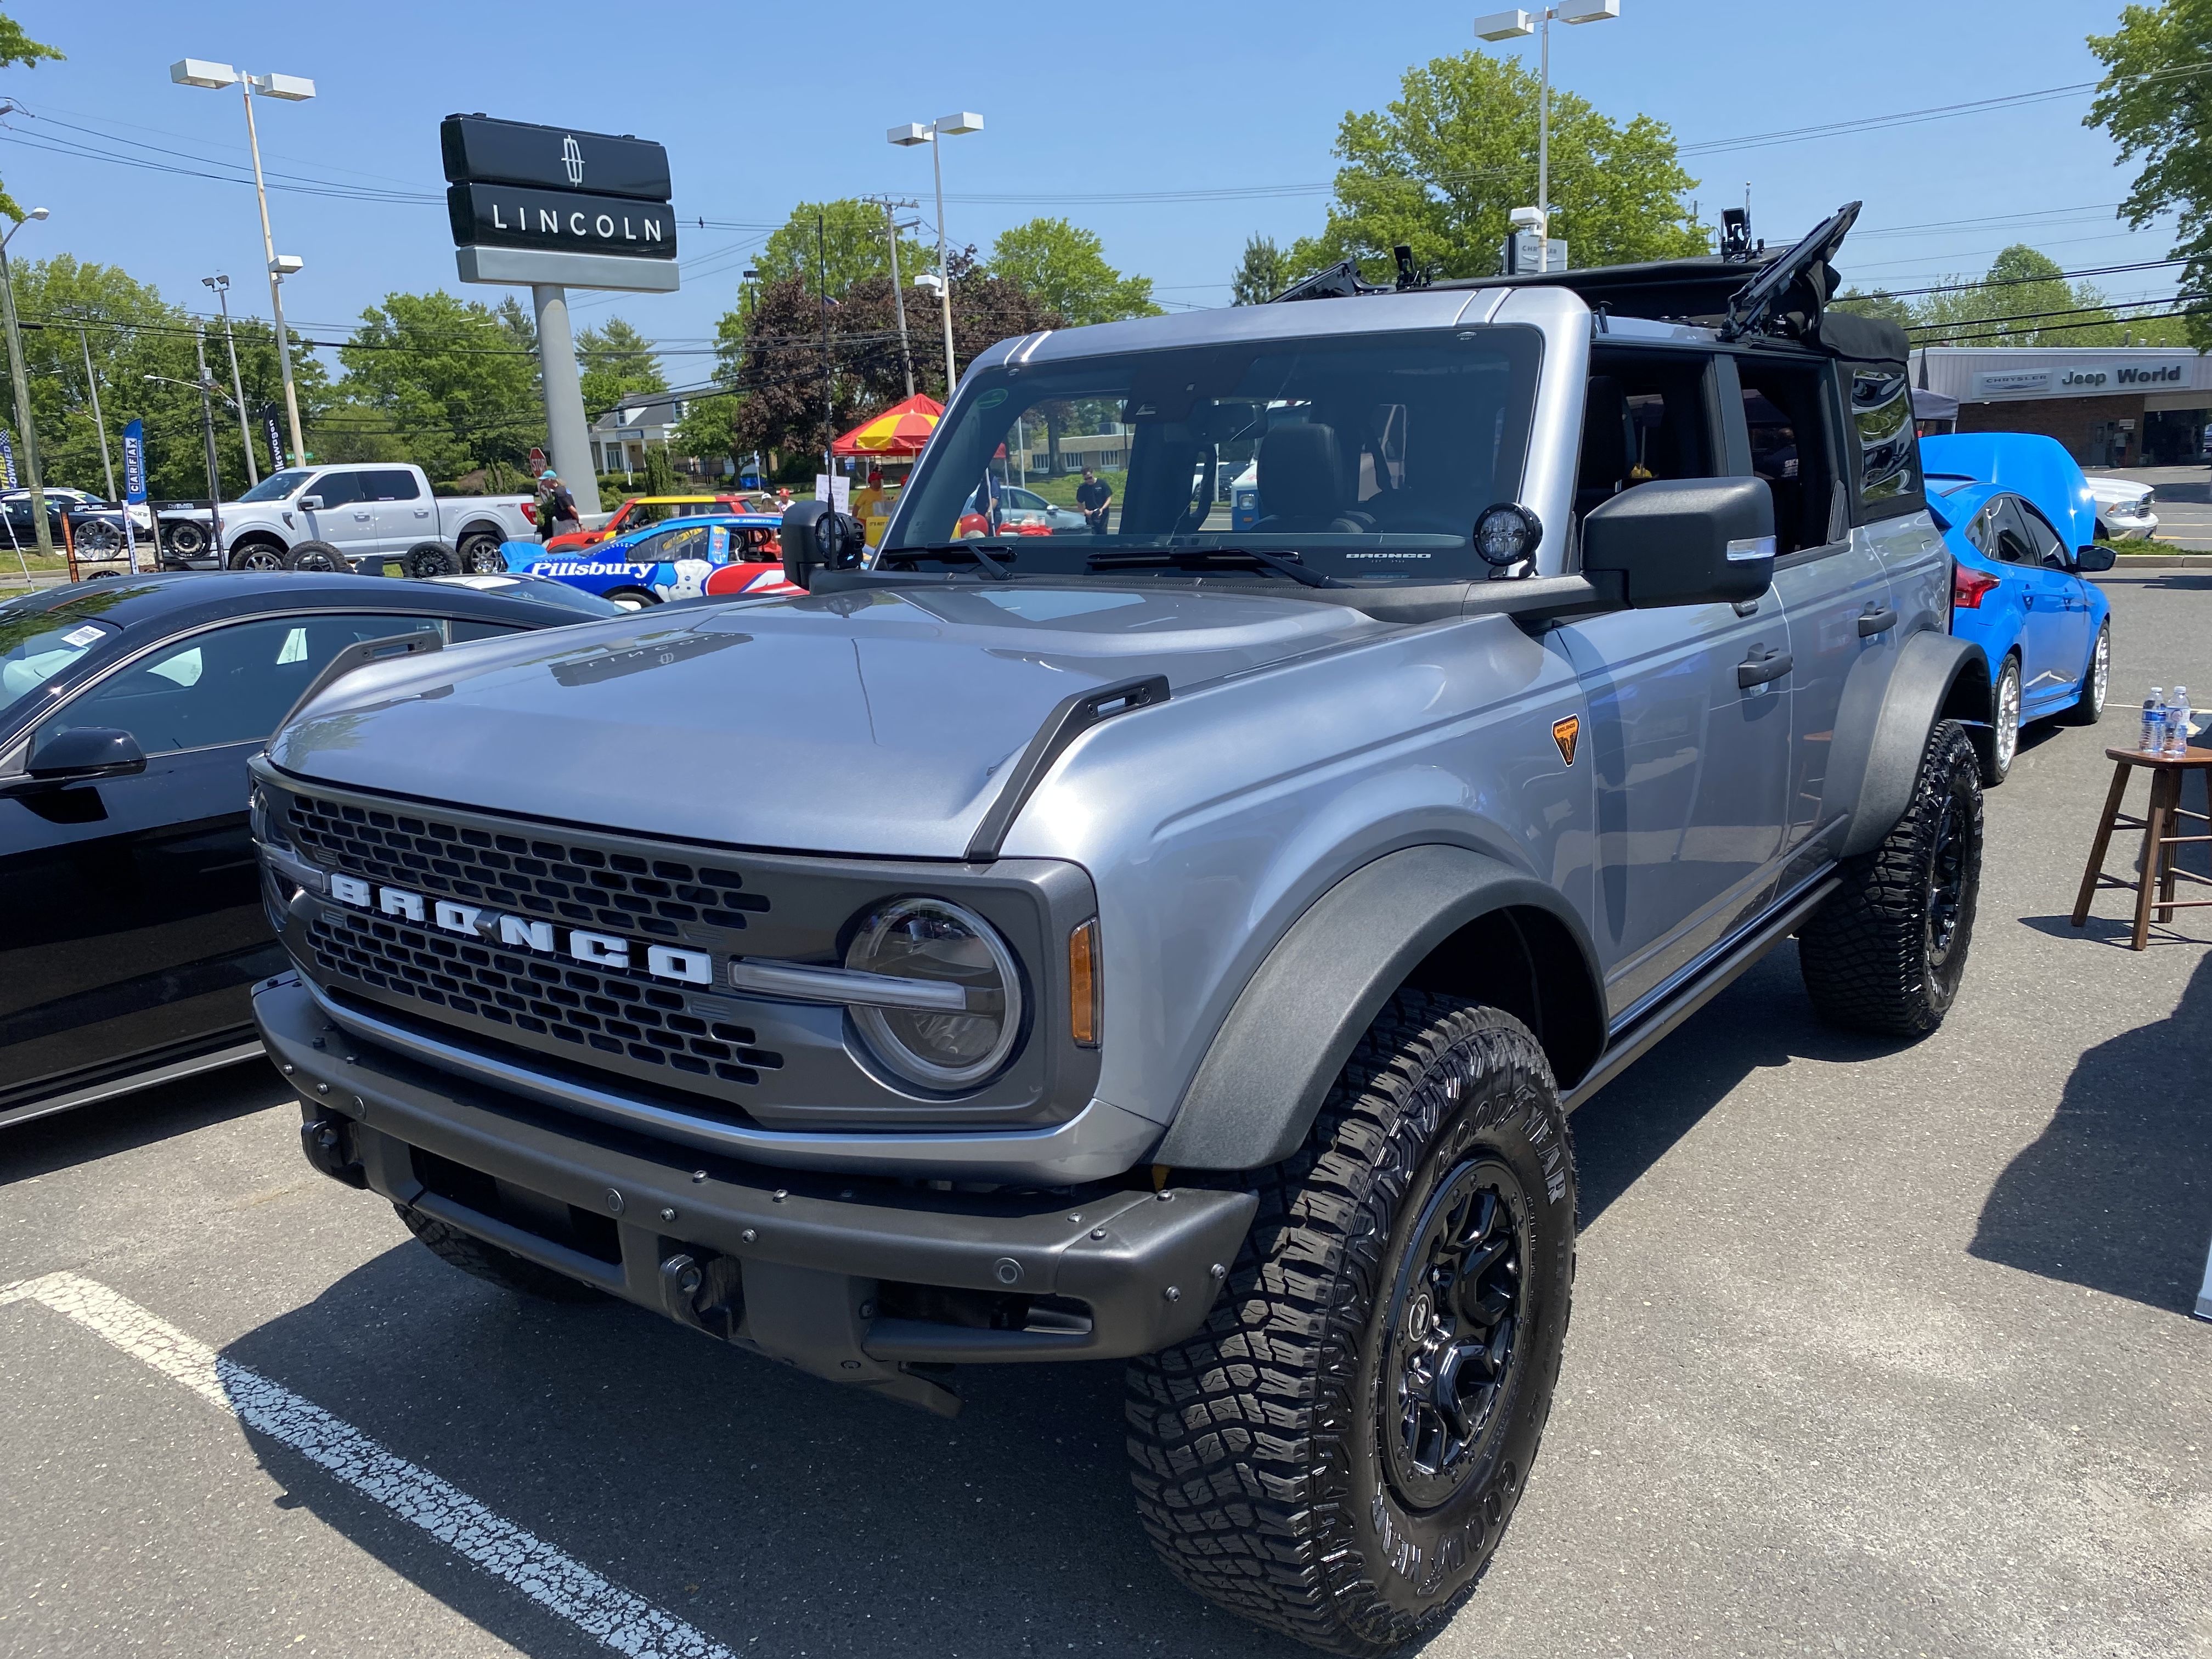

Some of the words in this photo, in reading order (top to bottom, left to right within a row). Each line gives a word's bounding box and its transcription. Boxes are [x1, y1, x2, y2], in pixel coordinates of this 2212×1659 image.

[493, 204, 662, 242] LINCOLN
[1522, 245, 1557, 255] CHRLER
[1986, 375, 2047, 383] CHRYSLER
[2062, 369, 2106, 386] Jeep
[2118, 366, 2181, 383] World
[3, 445, 17, 489] -OWNED
[127, 439, 140, 493] CARFAX
[532, 458, 546, 471] STOP
[531, 562, 656, 579] Pillsbury
[331, 872, 713, 985] BRONCO
